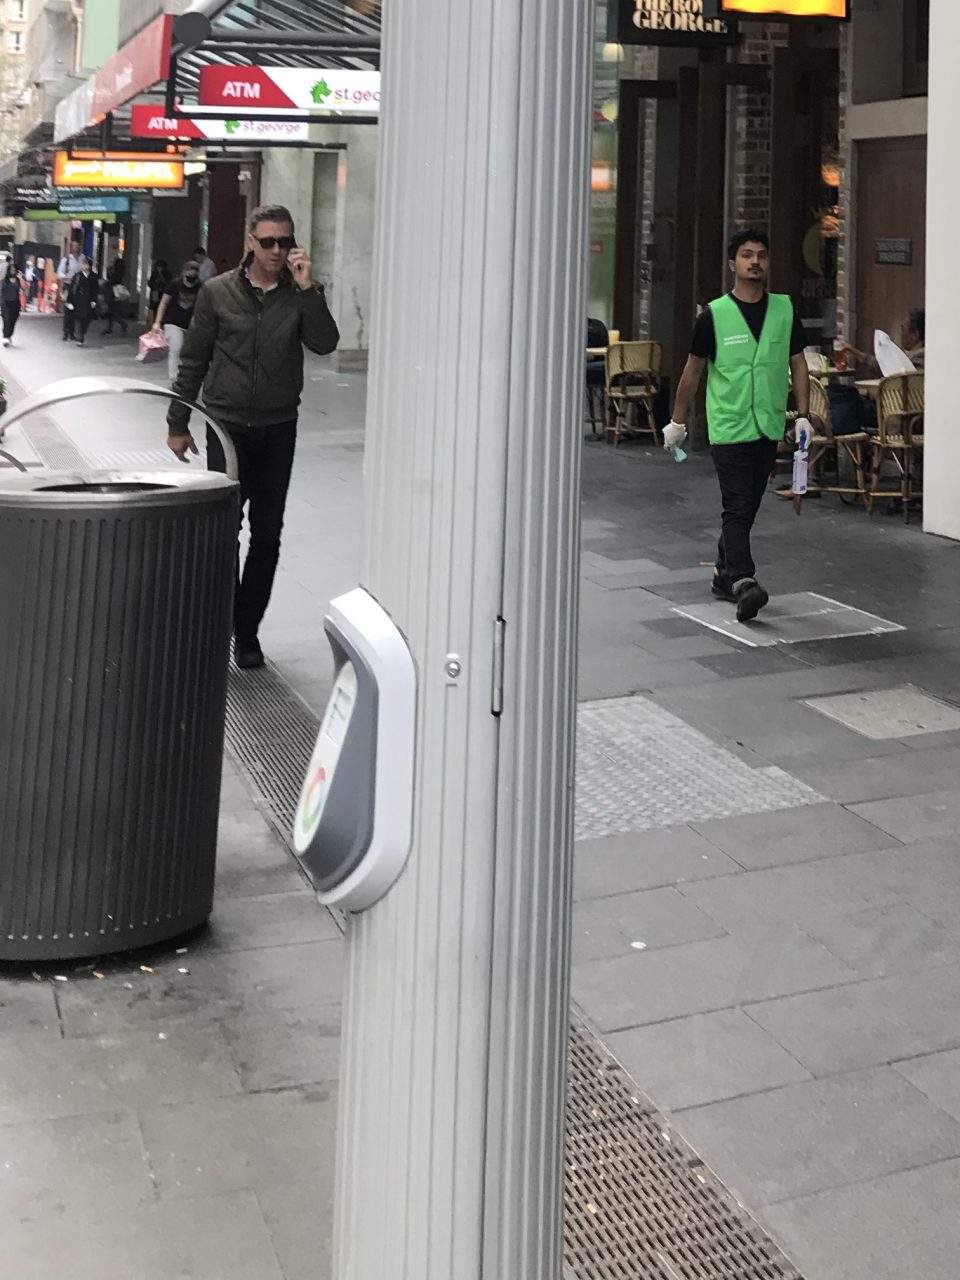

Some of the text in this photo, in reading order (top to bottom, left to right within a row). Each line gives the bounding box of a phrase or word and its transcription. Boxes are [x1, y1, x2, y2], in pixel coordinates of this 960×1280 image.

[632, 10, 728, 34] GEORGE
[222, 81, 261, 99] ATM
[148, 117, 178, 130] ATM
